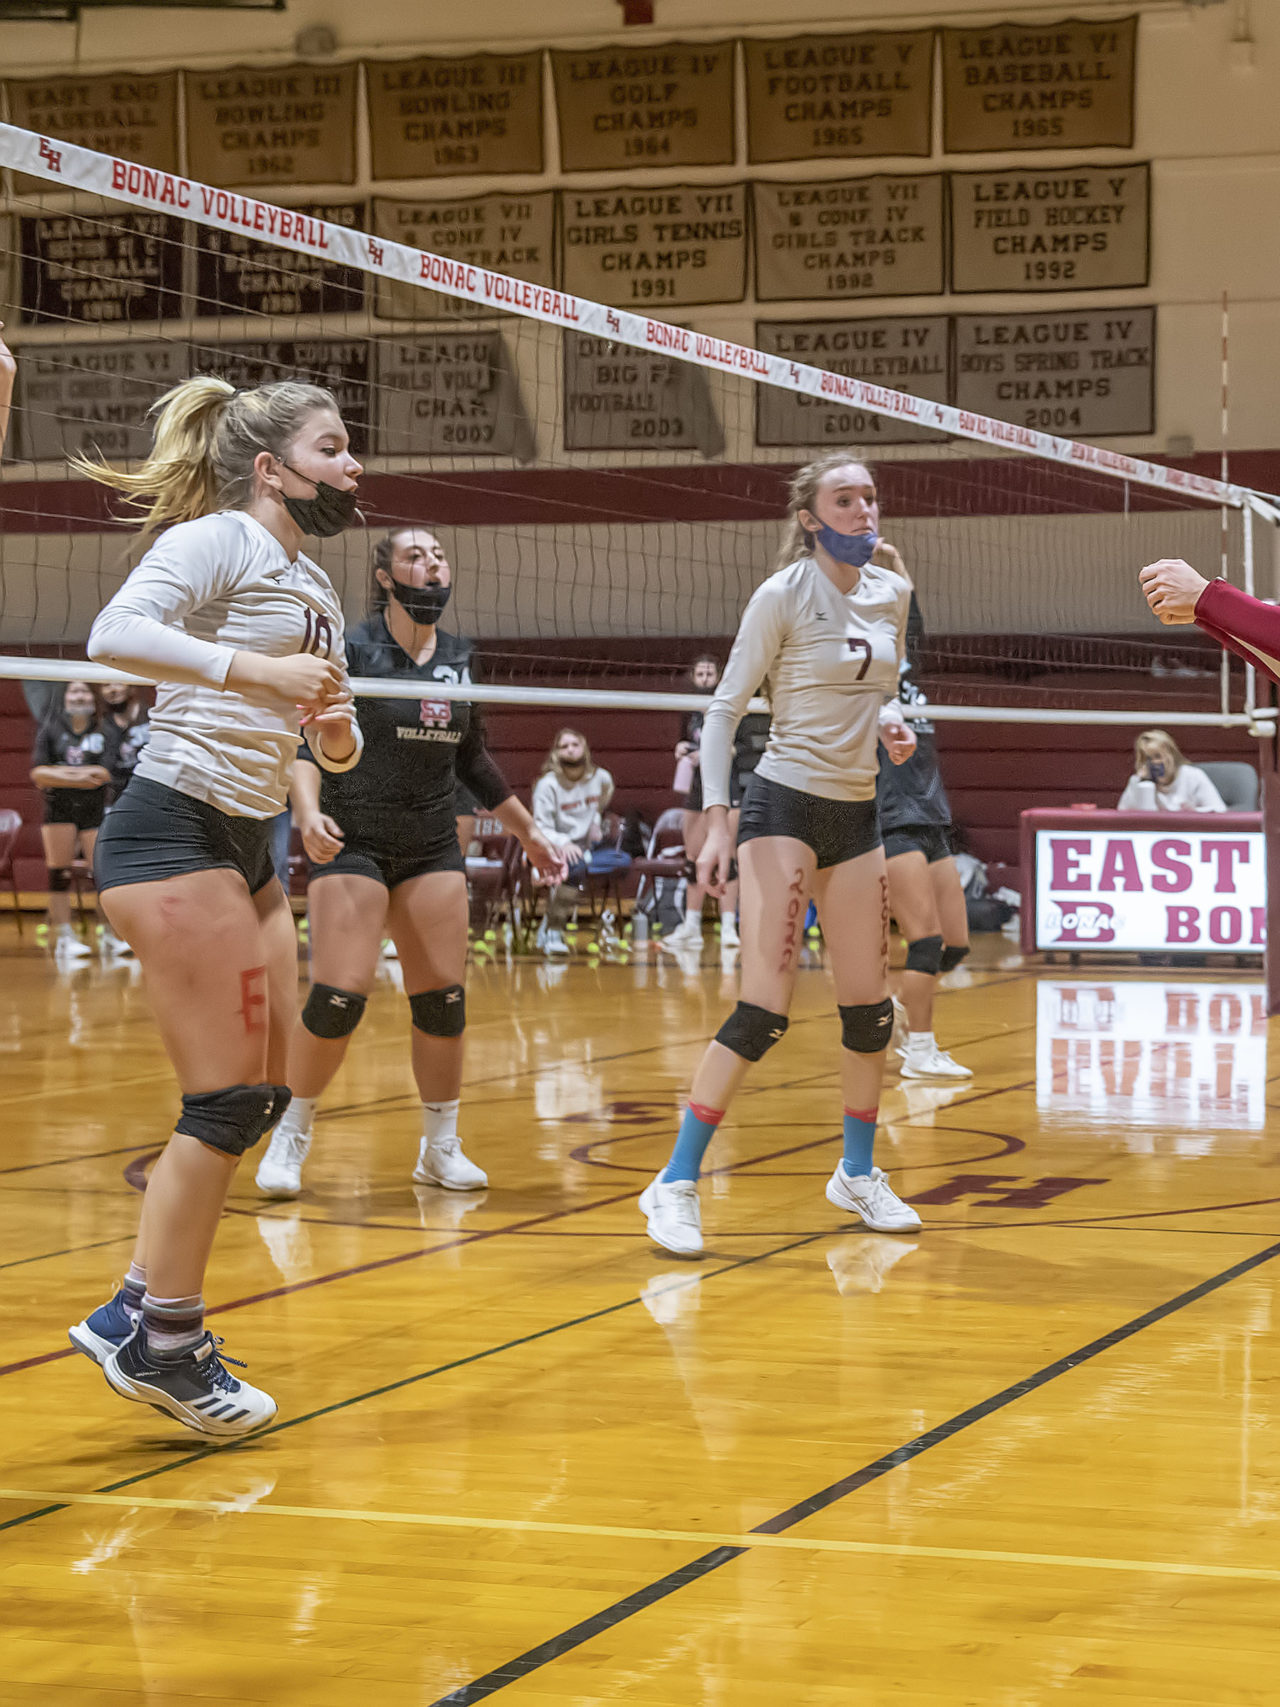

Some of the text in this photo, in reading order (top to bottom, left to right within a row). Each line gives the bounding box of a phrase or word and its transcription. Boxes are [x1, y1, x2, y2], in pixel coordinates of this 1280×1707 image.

[764, 44, 875, 71] LEAGUE
[958, 35, 1071, 60] LEAGUE
[382, 65, 486, 91] LEAGUE
[569, 54, 677, 81] LEAGUE
[965, 61, 1111, 86] BASEBALL
[202, 77, 299, 100] LEAGUE
[609, 82, 680, 106] GOLF
[767, 71, 911, 95] FOOTBALL
[784, 98, 892, 122] CHAMPS
[982, 89, 1093, 113] CHAMPS
[405, 118, 507, 142] CHAMPS
[593, 108, 699, 133] CHAMPS
[221, 128, 321, 150] CHAMPS
[777, 185, 870, 207] LEAGUE
[974, 178, 1090, 203] LEAGUE
[397, 203, 487, 226] LEAGUE
[576, 194, 682, 219] LEAGUE
[974, 205, 1125, 229] FIELD HOCKEY
[567, 219, 743, 246] GIRLS TENNIS
[849, 226, 926, 247] TRACK
[992, 232, 1109, 255] CHAMPS
[112, 159, 191, 209] BONAC
[201, 184, 329, 250] VOLLEYBALL
[420, 253, 476, 293] BONAC
[484, 271, 579, 322] VOLLEYBALL
[646, 321, 690, 353] BONAC
[695, 332, 770, 376] VOLLEYBALL
[601, 250, 708, 272] CHAMPS
[804, 249, 897, 270] CHAMPS
[1023, 261, 1076, 282] 1992
[631, 278, 676, 298] 1991
[774, 327, 931, 353] LEAGUE IV
[974, 320, 1134, 346] LEAGUE IV
[400, 344, 488, 365] LEAGU
[1014, 349, 1079, 373] SPRING
[1090, 346, 1150, 369] TRACK
[597, 365, 639, 385] BIG
[996, 377, 1112, 401] CHAMPS
[1024, 407, 1084, 428] 2004
[847, 637, 872, 681] 7
[1049, 838, 1251, 893] EAST
